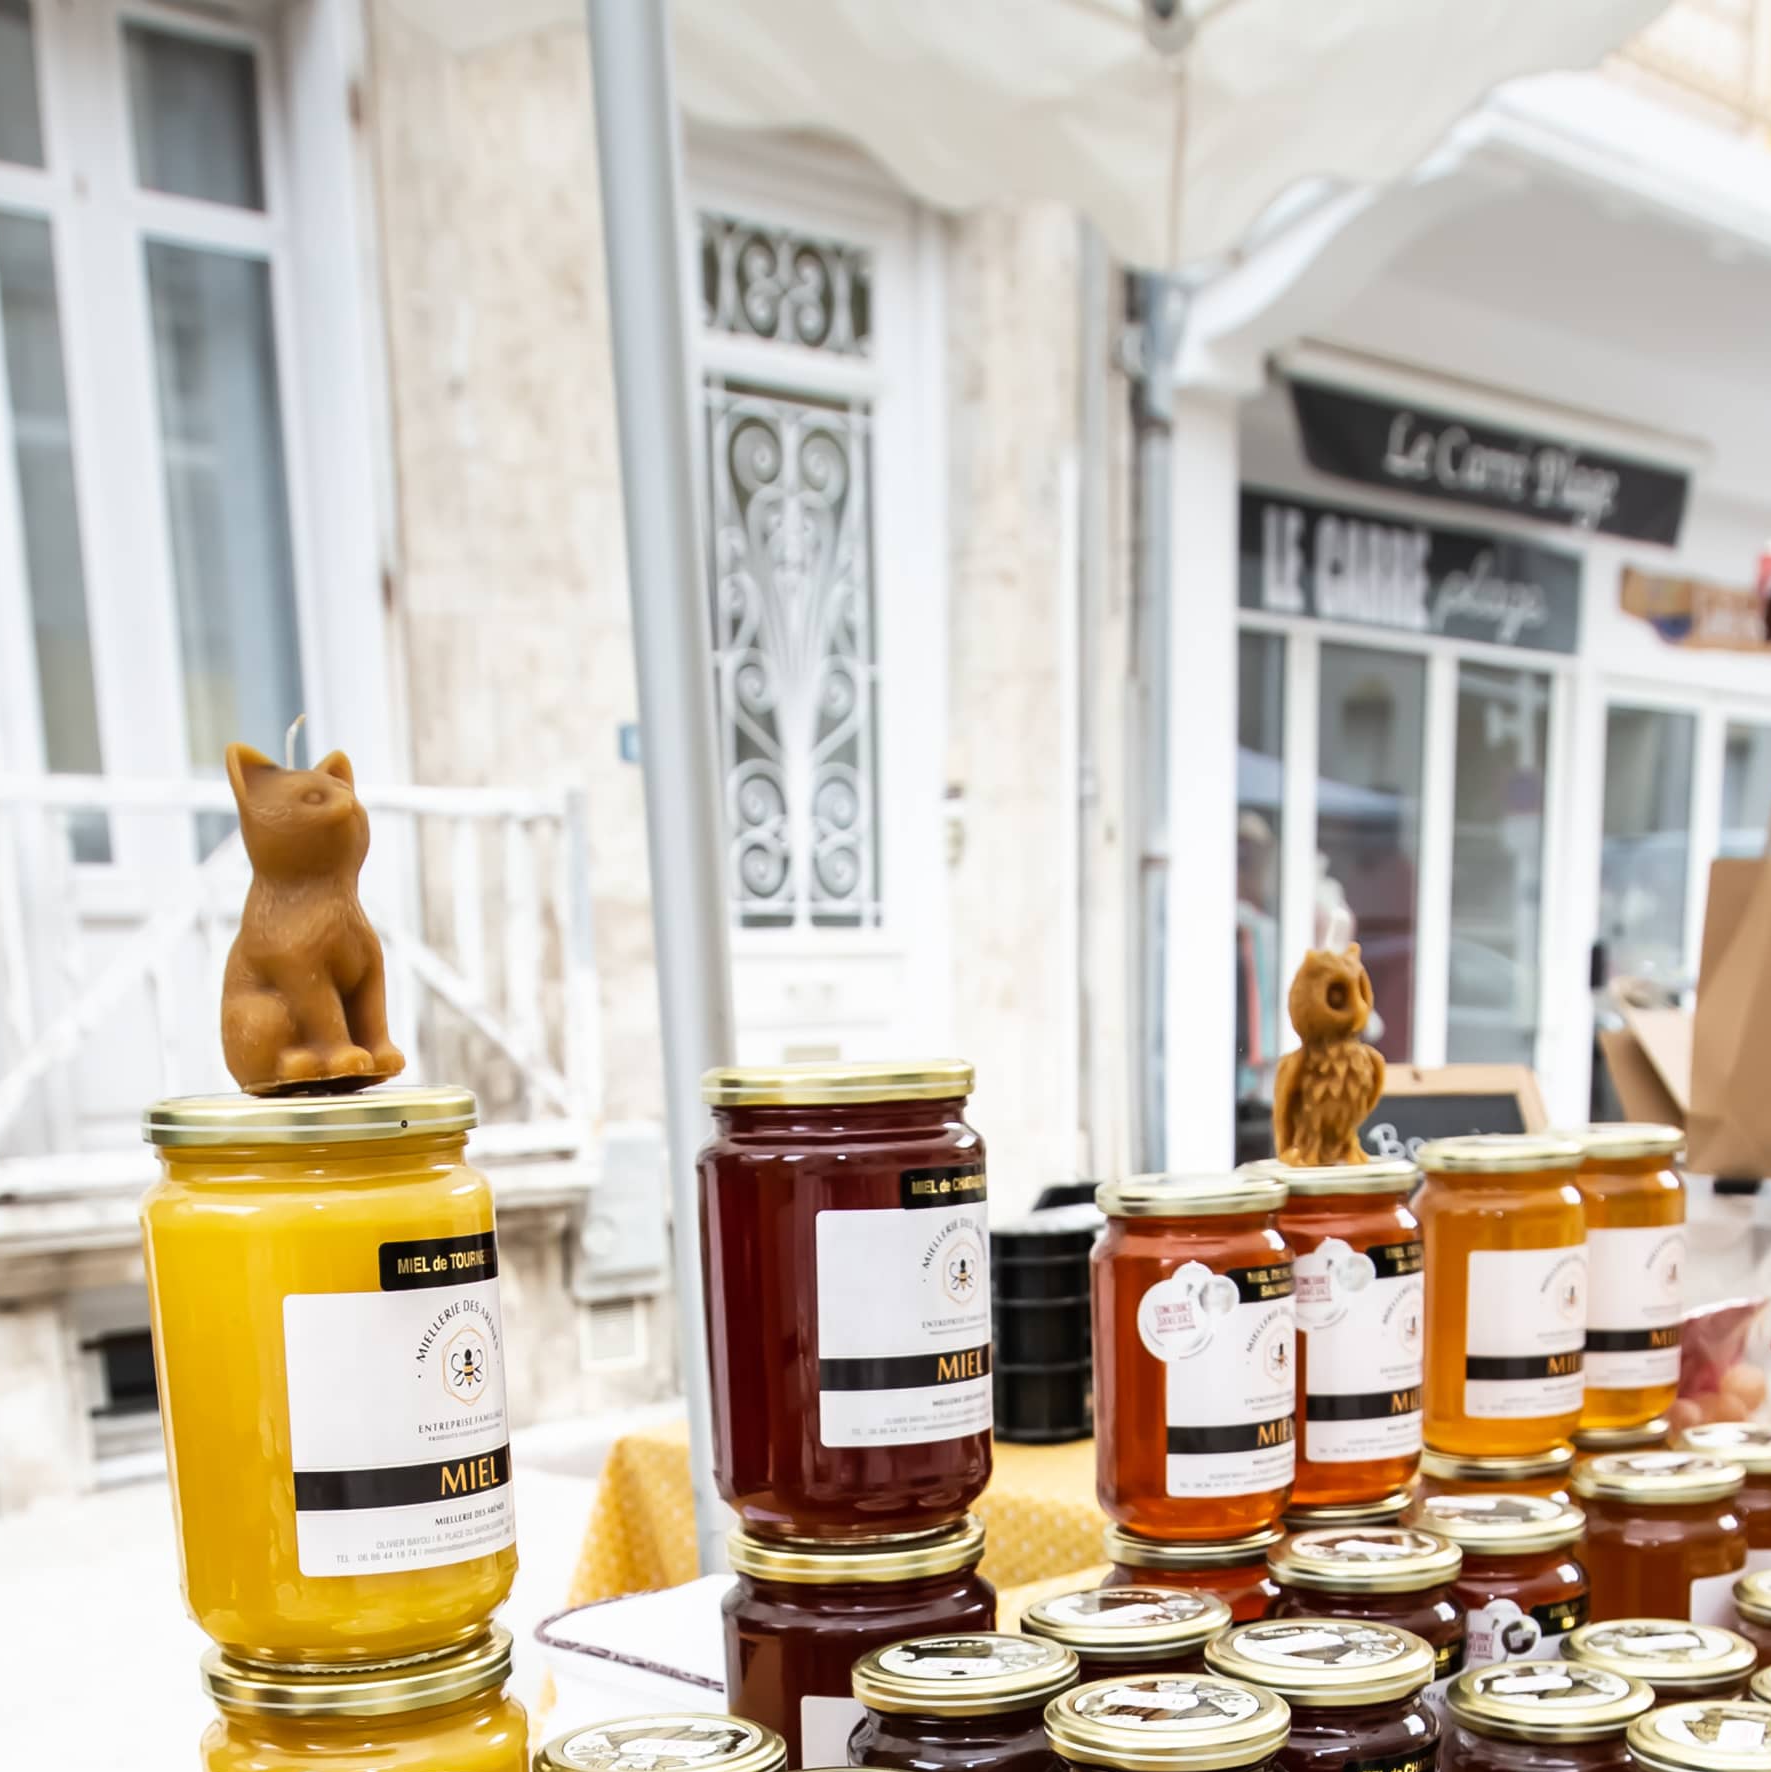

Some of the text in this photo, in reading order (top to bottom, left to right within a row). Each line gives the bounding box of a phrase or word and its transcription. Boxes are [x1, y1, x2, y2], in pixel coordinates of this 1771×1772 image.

[397, 1256, 448, 1274] MIEL de
[937, 1351, 983, 1382] MIEL
[440, 1455, 500, 1496] MIEL
